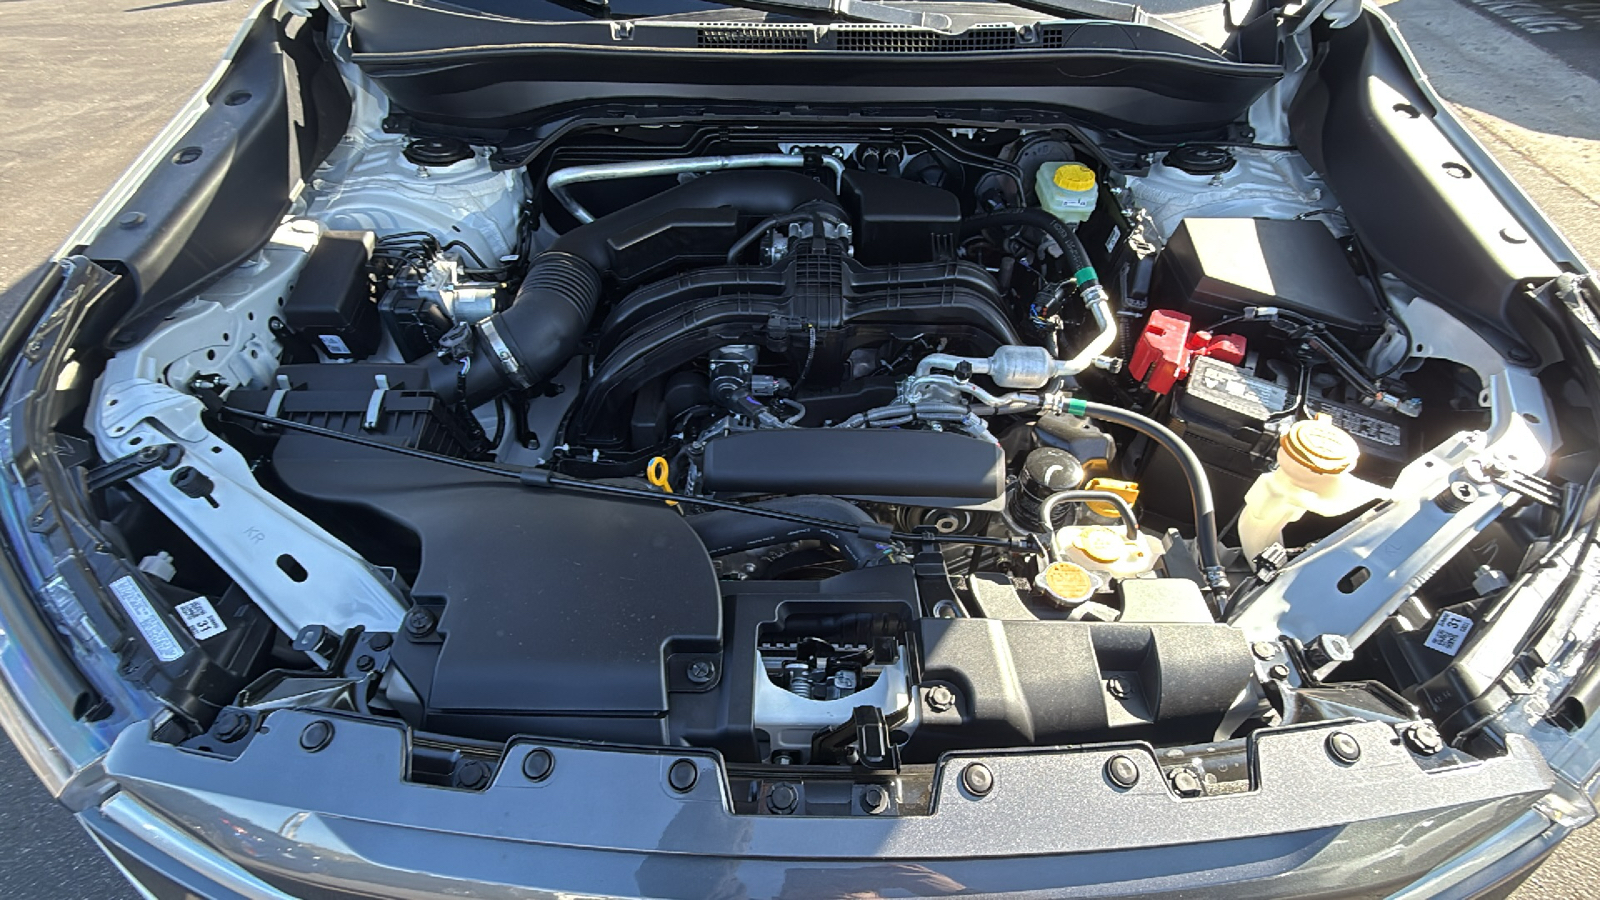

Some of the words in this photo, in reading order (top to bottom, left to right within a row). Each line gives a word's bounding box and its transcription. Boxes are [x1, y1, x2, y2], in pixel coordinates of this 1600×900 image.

[243, 526, 265, 544] KR
[197, 619, 212, 633] 31
[1448, 617, 1461, 629] 31
